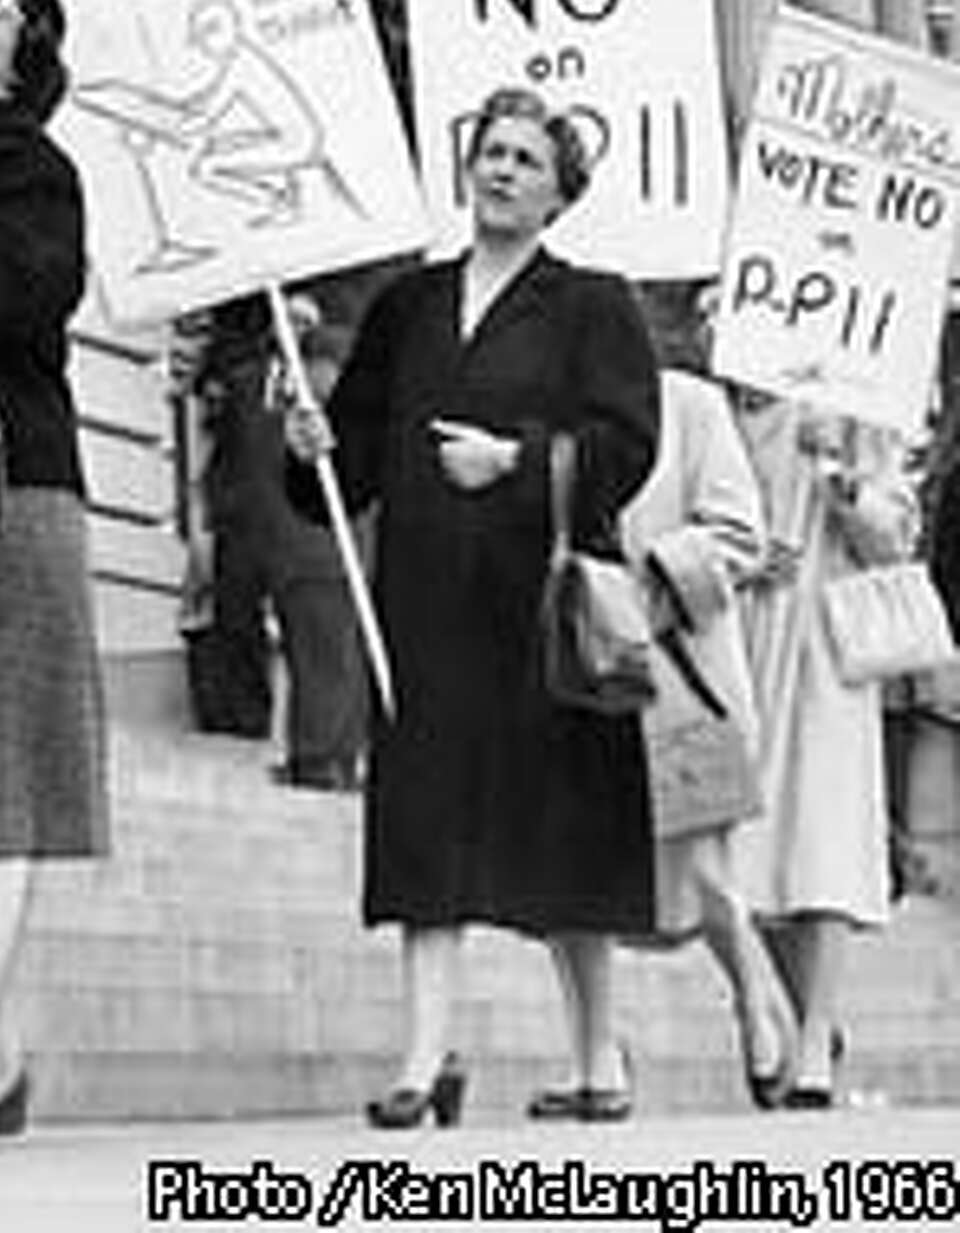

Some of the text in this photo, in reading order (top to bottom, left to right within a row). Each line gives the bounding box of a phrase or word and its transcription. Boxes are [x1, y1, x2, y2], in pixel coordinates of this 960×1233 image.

[526, 45, 584, 81] on
[758, 141, 943, 228] VOTE NO
